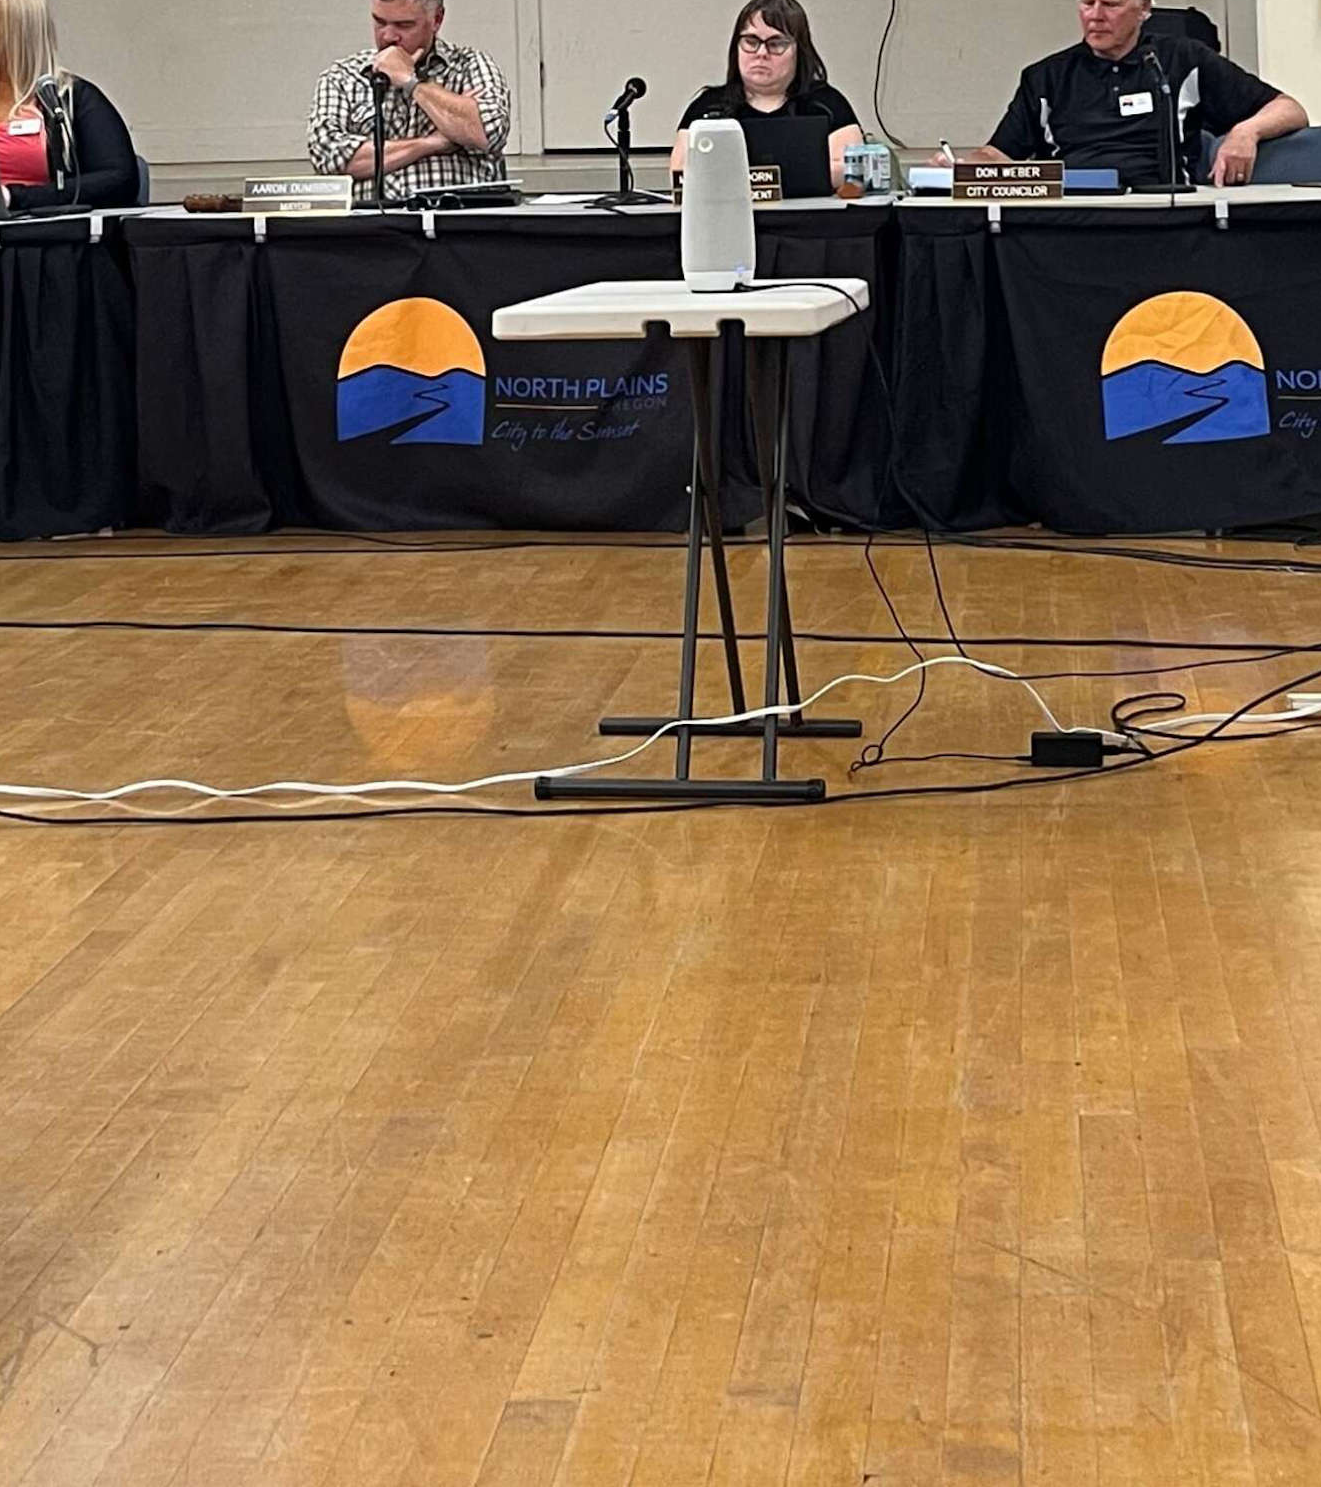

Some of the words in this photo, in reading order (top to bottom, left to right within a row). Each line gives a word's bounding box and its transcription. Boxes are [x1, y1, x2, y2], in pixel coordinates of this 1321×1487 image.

[975, 167, 998, 179] DON
[1001, 166, 1041, 178] WEBER
[251, 183, 288, 195] AARON
[966, 186, 989, 197] CITY
[991, 185, 1048, 197] COUNCILOR
[495, 376, 579, 399] NORTH
[585, 373, 669, 399] PLAINS
[1278, 410, 1318, 438] City
[491, 419, 528, 452] City
[549, 416, 574, 441] the
[576, 417, 642, 441] Sunset
